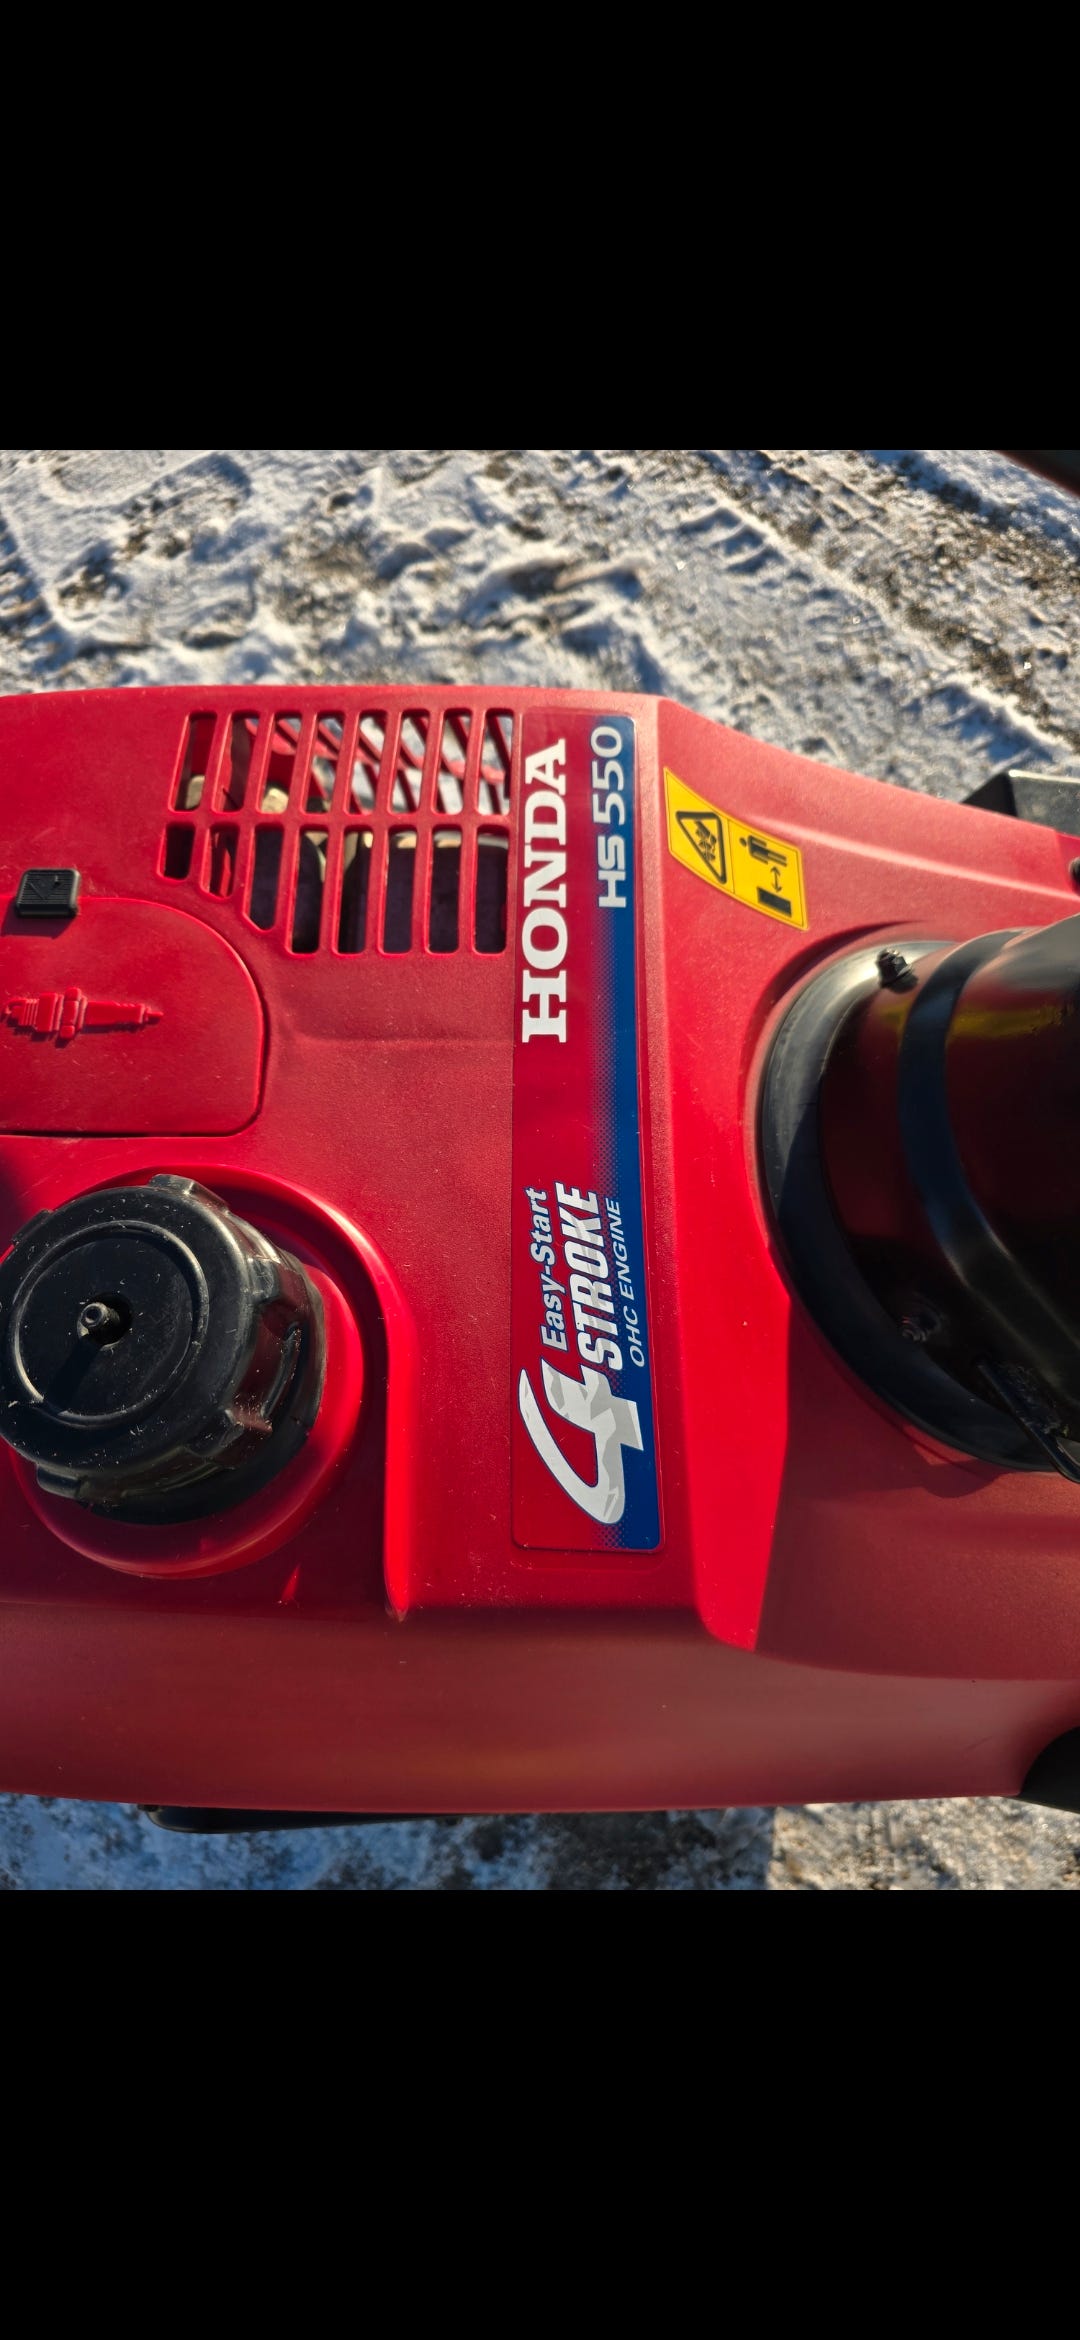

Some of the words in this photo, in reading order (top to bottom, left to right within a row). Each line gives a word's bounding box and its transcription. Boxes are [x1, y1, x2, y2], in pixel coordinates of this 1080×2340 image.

[590, 725, 626, 825] 550
[522, 738, 568, 1043] HONDA
[597, 834, 627, 909] HS
[525, 1186, 567, 1351] Easy-Start
[554, 1181, 623, 1371] STROKE
[605, 1197, 635, 1301] ENGINE
[620, 1307, 645, 1368] OHC
[518, 1357, 644, 1525] 4
